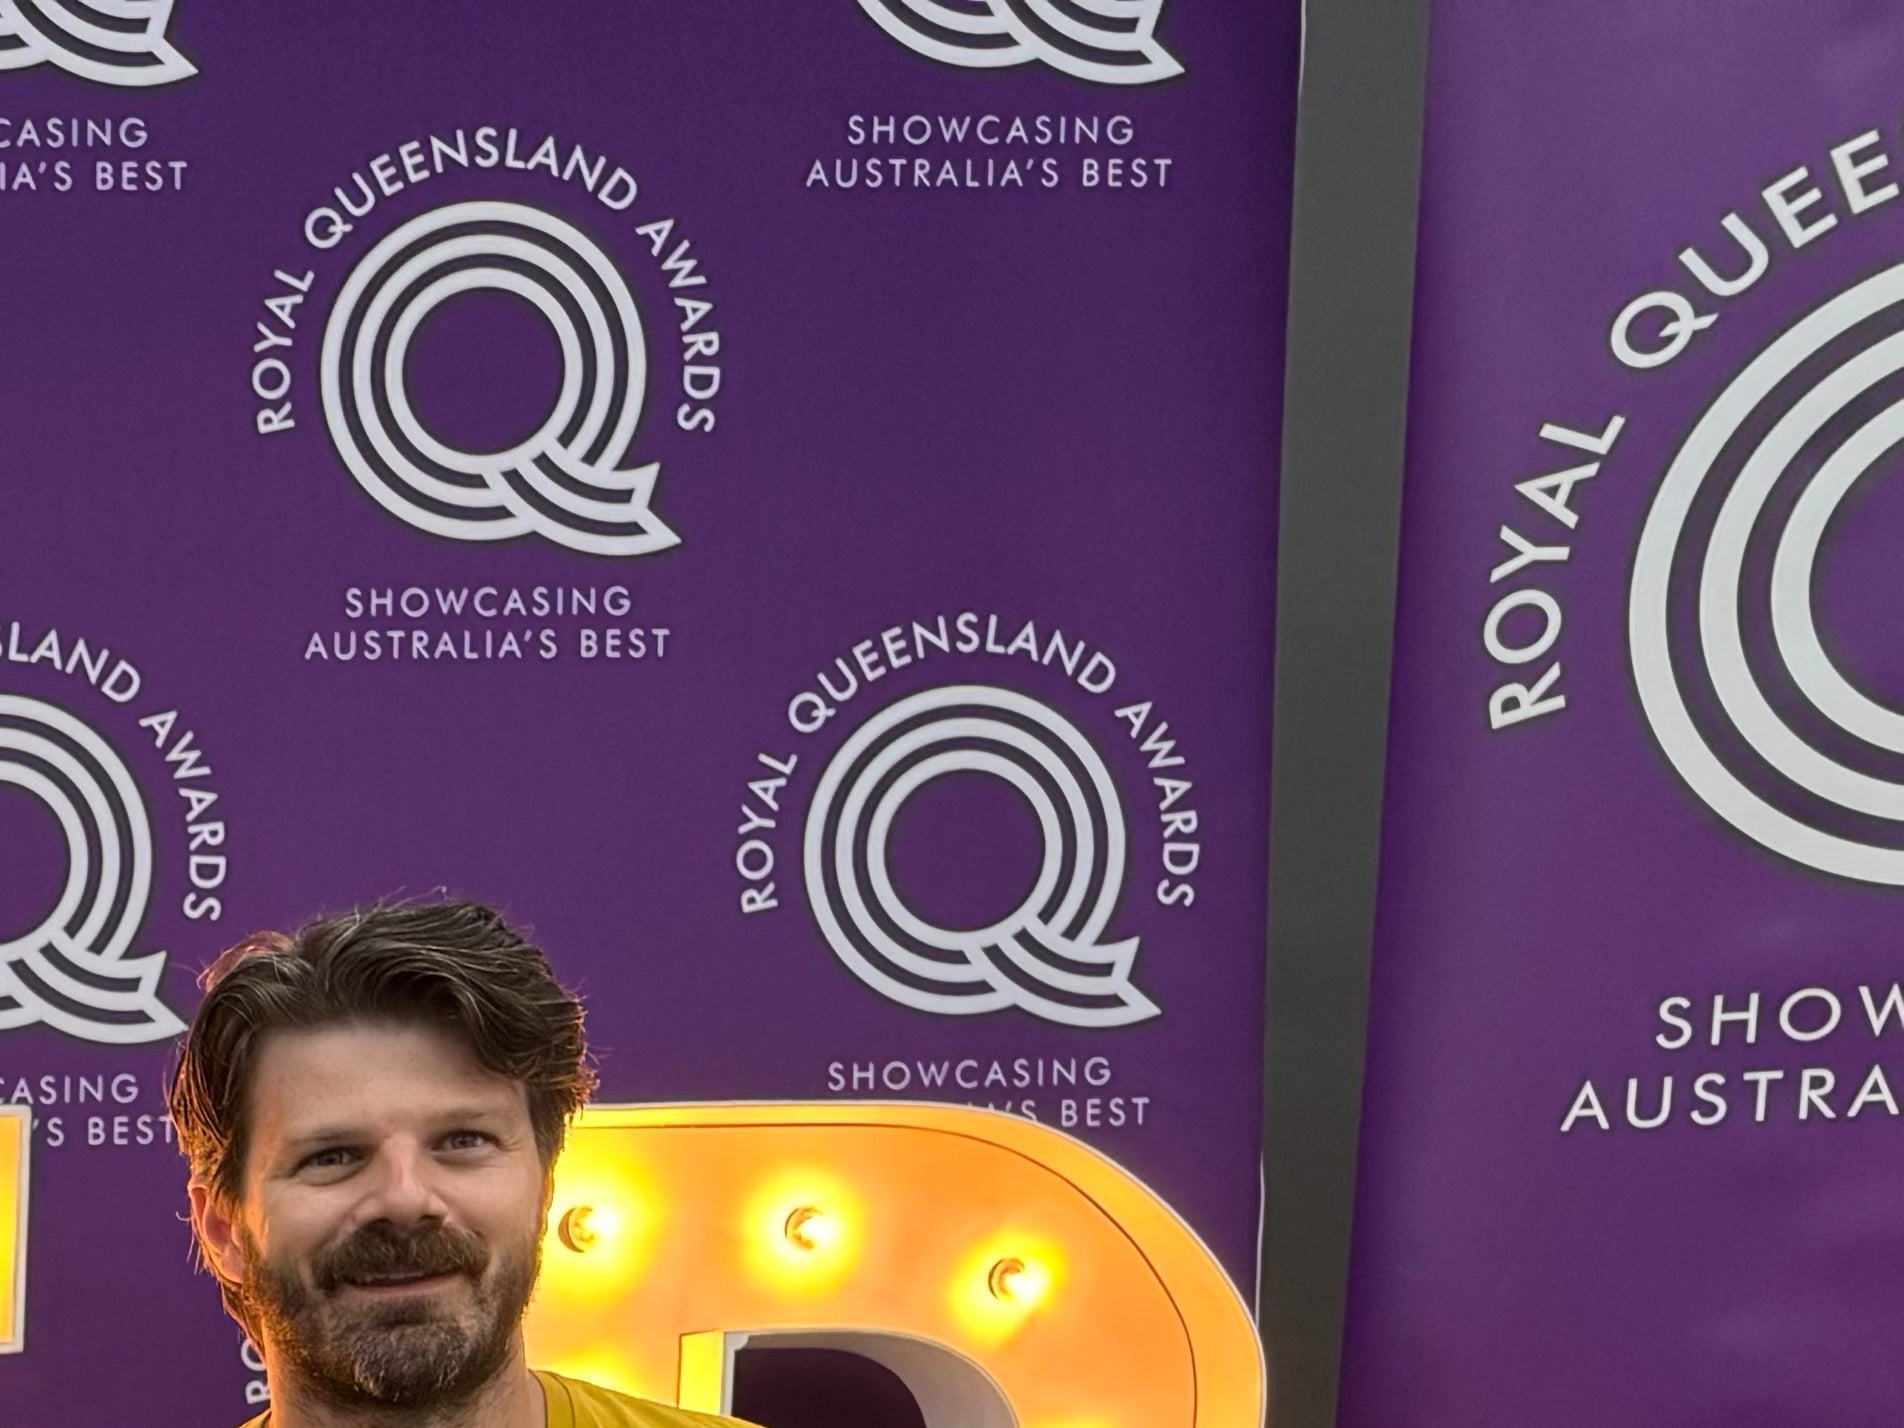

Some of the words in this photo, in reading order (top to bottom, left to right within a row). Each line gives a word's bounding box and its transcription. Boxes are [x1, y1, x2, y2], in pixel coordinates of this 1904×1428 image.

[848, 115, 1133, 145] SHOWCASING
[96, 160, 188, 191] BEST
[806, 157, 1059, 188] AUSTRALIA'S
[1082, 157, 1172, 188] BEST
[252, 270, 315, 434] ROYAL
[304, 126, 637, 249] QUEENSLAND
[635, 219, 721, 432] AWARDS
[1483, 415, 1626, 730] ROYAL
[345, 586, 631, 618] SHOWCASING
[304, 628, 557, 661] AUSTRALIA'S
[580, 628, 670, 658] BEST
[736, 753, 798, 913] ROYAL
[788, 612, 1116, 733] QUEENSLAND
[1114, 701, 1200, 907] AWARDS
[139, 710, 227, 921] AWARDS
[828, 1056, 1112, 1091] SHOWCASING
[1061, 1097, 1149, 1127] BEST
[1560, 1064, 1899, 1132] AUSTRA
[88, 1115, 175, 1146] BEST
